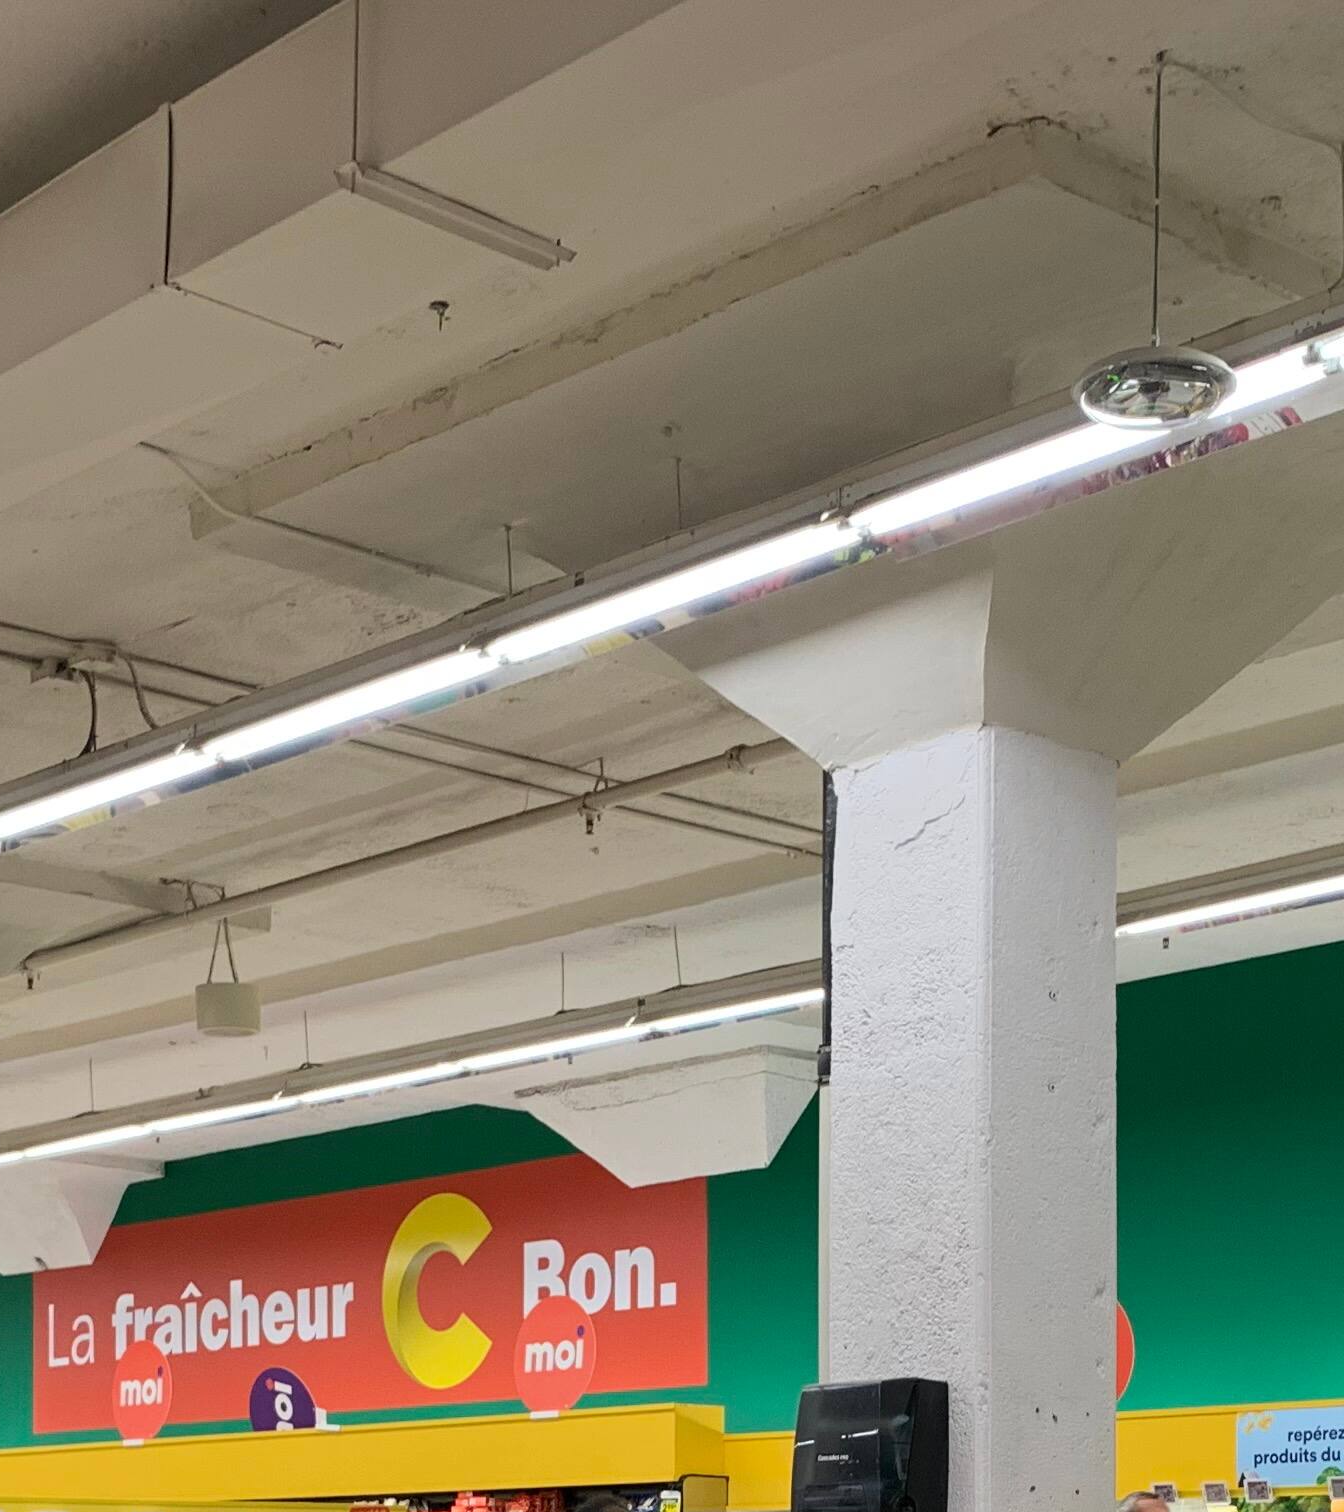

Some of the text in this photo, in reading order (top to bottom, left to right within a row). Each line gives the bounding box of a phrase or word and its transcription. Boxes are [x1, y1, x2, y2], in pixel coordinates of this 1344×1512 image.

[47, 1302, 95, 1368] La
[111, 1279, 355, 1359] fraîcheur
[523, 1238, 677, 1319] Bon.
[524, 1324, 586, 1373] moi
[119, 1365, 165, 1408] moi
[1253, 1448, 1317, 1468] produits
[1321, 1446, 1341, 1462] du
